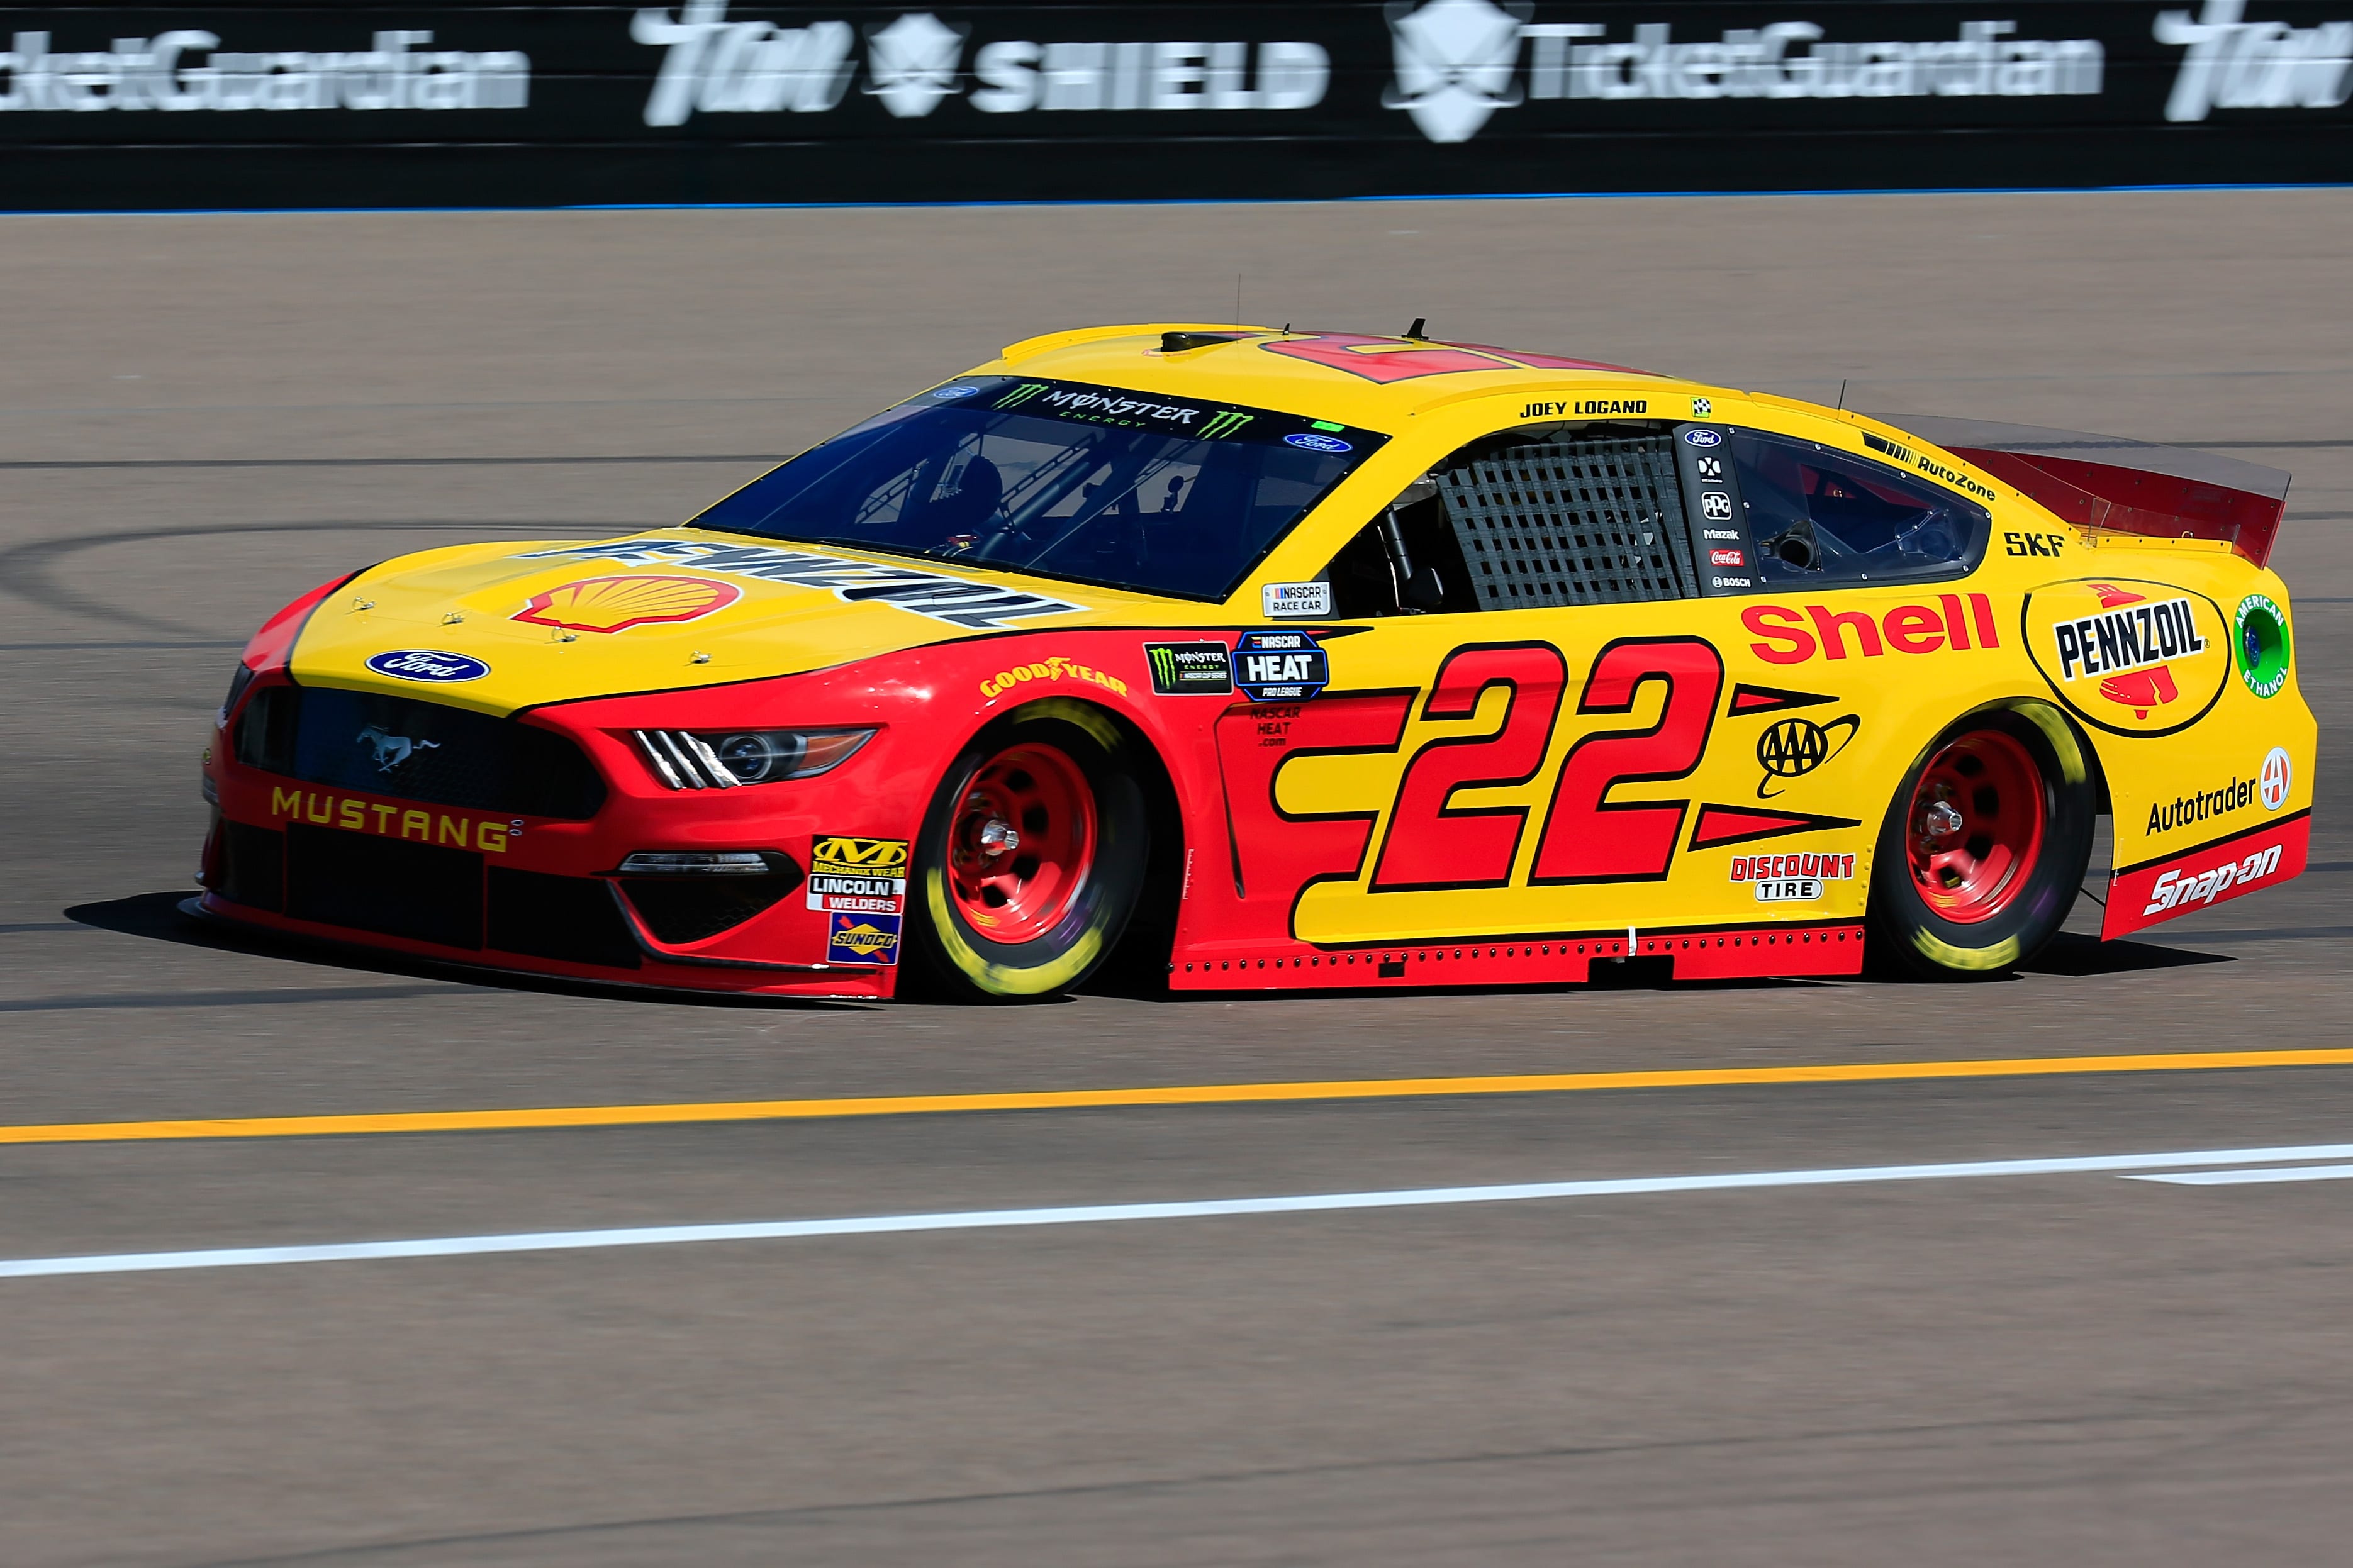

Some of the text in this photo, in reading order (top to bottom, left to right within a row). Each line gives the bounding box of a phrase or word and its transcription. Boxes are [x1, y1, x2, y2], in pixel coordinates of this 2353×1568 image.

[1517, 21, 2104, 99] TicketGuardian
[971, 41, 1330, 113] SHIELD
[1520, 400, 1647, 418] JOEY LOGANO
[1059, 411, 1146, 428] ENERGY
[1294, 435, 1341, 450] Ford
[1918, 455, 1996, 501] AutoZone
[1704, 495, 1730, 516] PPG
[1703, 529, 1740, 540] Mazak
[2004, 532, 2065, 557] SKF
[1723, 577, 1751, 587] BOSCH
[1284, 586, 1321, 599] NASCAR
[1273, 601, 1321, 611] RACE CAR
[2235, 595, 2284, 629] AMERICAN
[1741, 592, 2001, 665] Shell
[1261, 636, 1300, 648] NASCAR
[2054, 599, 2203, 679] PENNZOIL
[383, 652, 469, 677] Ford
[1246, 655, 1312, 681] HEAT
[1262, 687, 1302, 696] PRO LEAGUE
[2244, 667, 2287, 697] ETHANOL
[1250, 706, 1302, 720] NASCAR
[1257, 722, 1291, 735] HEAT
[1259, 738, 1287, 747] .com
[1760, 719, 1825, 776] AAA
[1368, 635, 1724, 894] 22
[2146, 776, 2256, 836] Autotrader
[271, 787, 508, 853] MUSTANG
[812, 860, 905, 877] MECHANIX WEAR
[1731, 853, 1855, 881] DISCOUNT
[813, 878, 889, 896] LINCOLN
[2142, 843, 2284, 916] Snap-on
[1761, 882, 1813, 898] TIRE
[829, 897, 897, 911] WELDERS
[837, 933, 896, 946] SUNOCO
